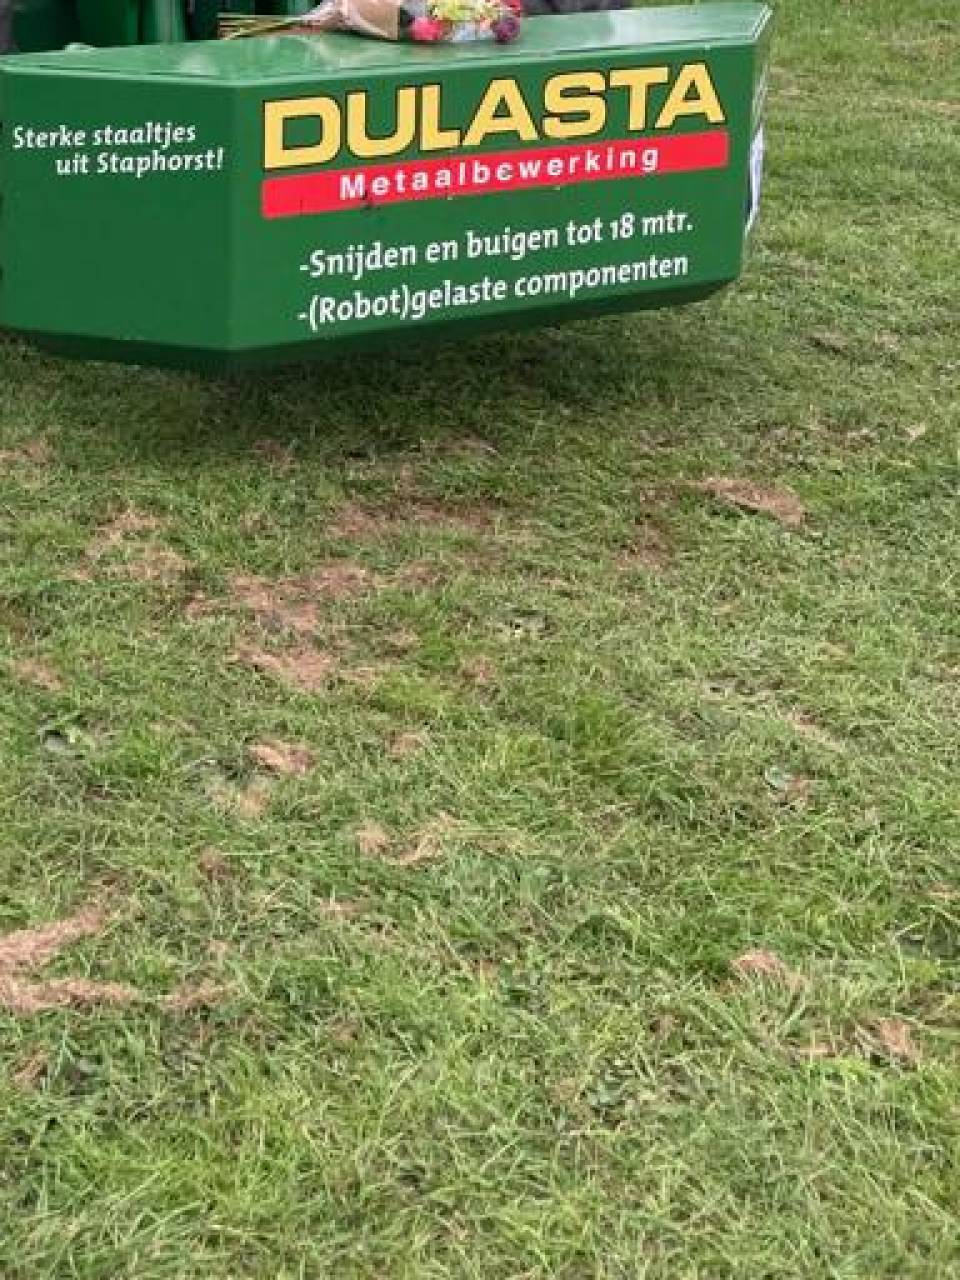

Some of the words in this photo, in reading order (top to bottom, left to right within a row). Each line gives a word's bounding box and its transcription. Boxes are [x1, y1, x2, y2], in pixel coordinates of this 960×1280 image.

[12, 125, 86, 149] Sterke
[92, 122, 196, 150] staaltjes
[263, 62, 726, 170] DULASTA
[54, 152, 89, 176] uit
[96, 146, 224, 178] Staphorst!
[340, 146, 659, 201] Metaalbewerking
[299, 240, 416, 281] -Snijden
[425, 239, 458, 263] en
[465, 226, 559, 261] buigen
[566, 218, 603, 246] tot
[609, 212, 636, 241] 18
[642, 208, 693, 236] mtr.
[297, 275, 507, 333] -(Robot)gelaste
[514, 254, 689, 299] componenten
